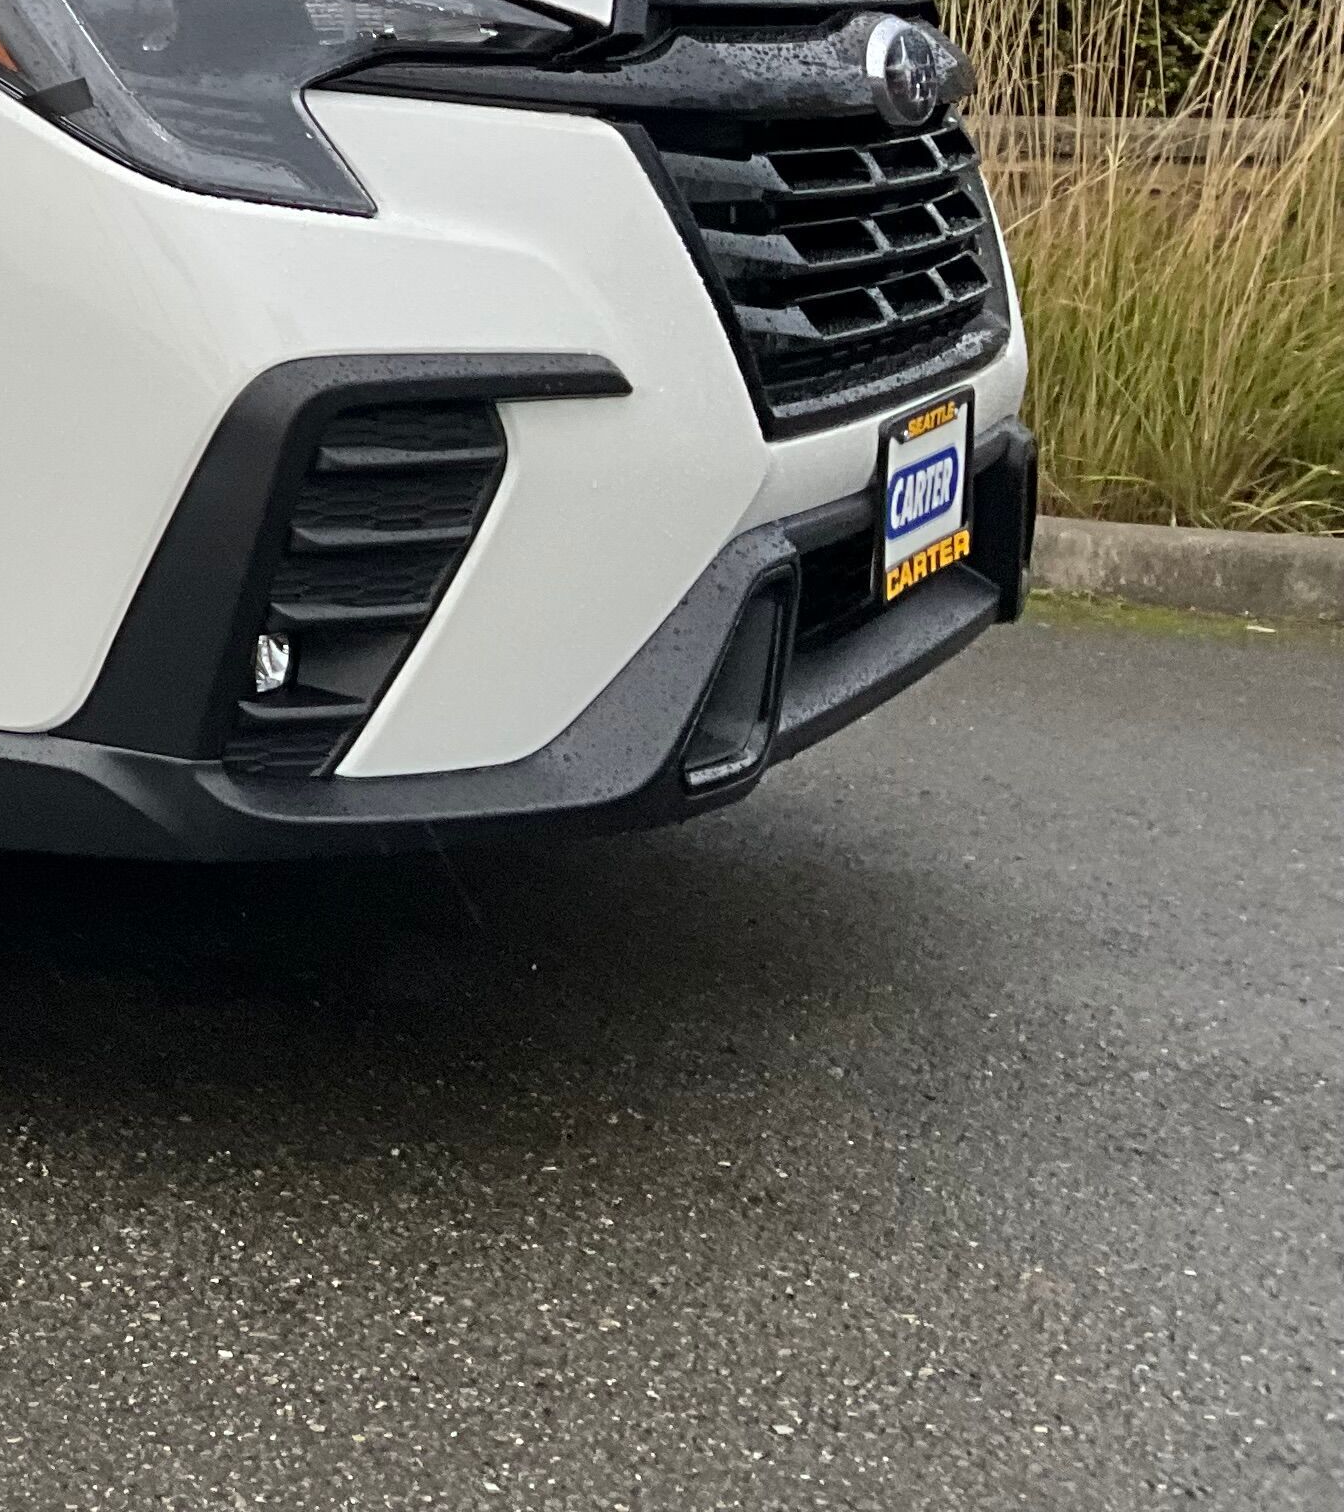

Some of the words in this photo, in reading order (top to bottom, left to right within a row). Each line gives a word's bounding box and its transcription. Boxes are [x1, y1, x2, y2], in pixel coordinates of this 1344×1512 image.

[907, 400, 956, 438] SEATTLE
[891, 456, 953, 530] CARTER
[886, 530, 971, 601] CARTER
